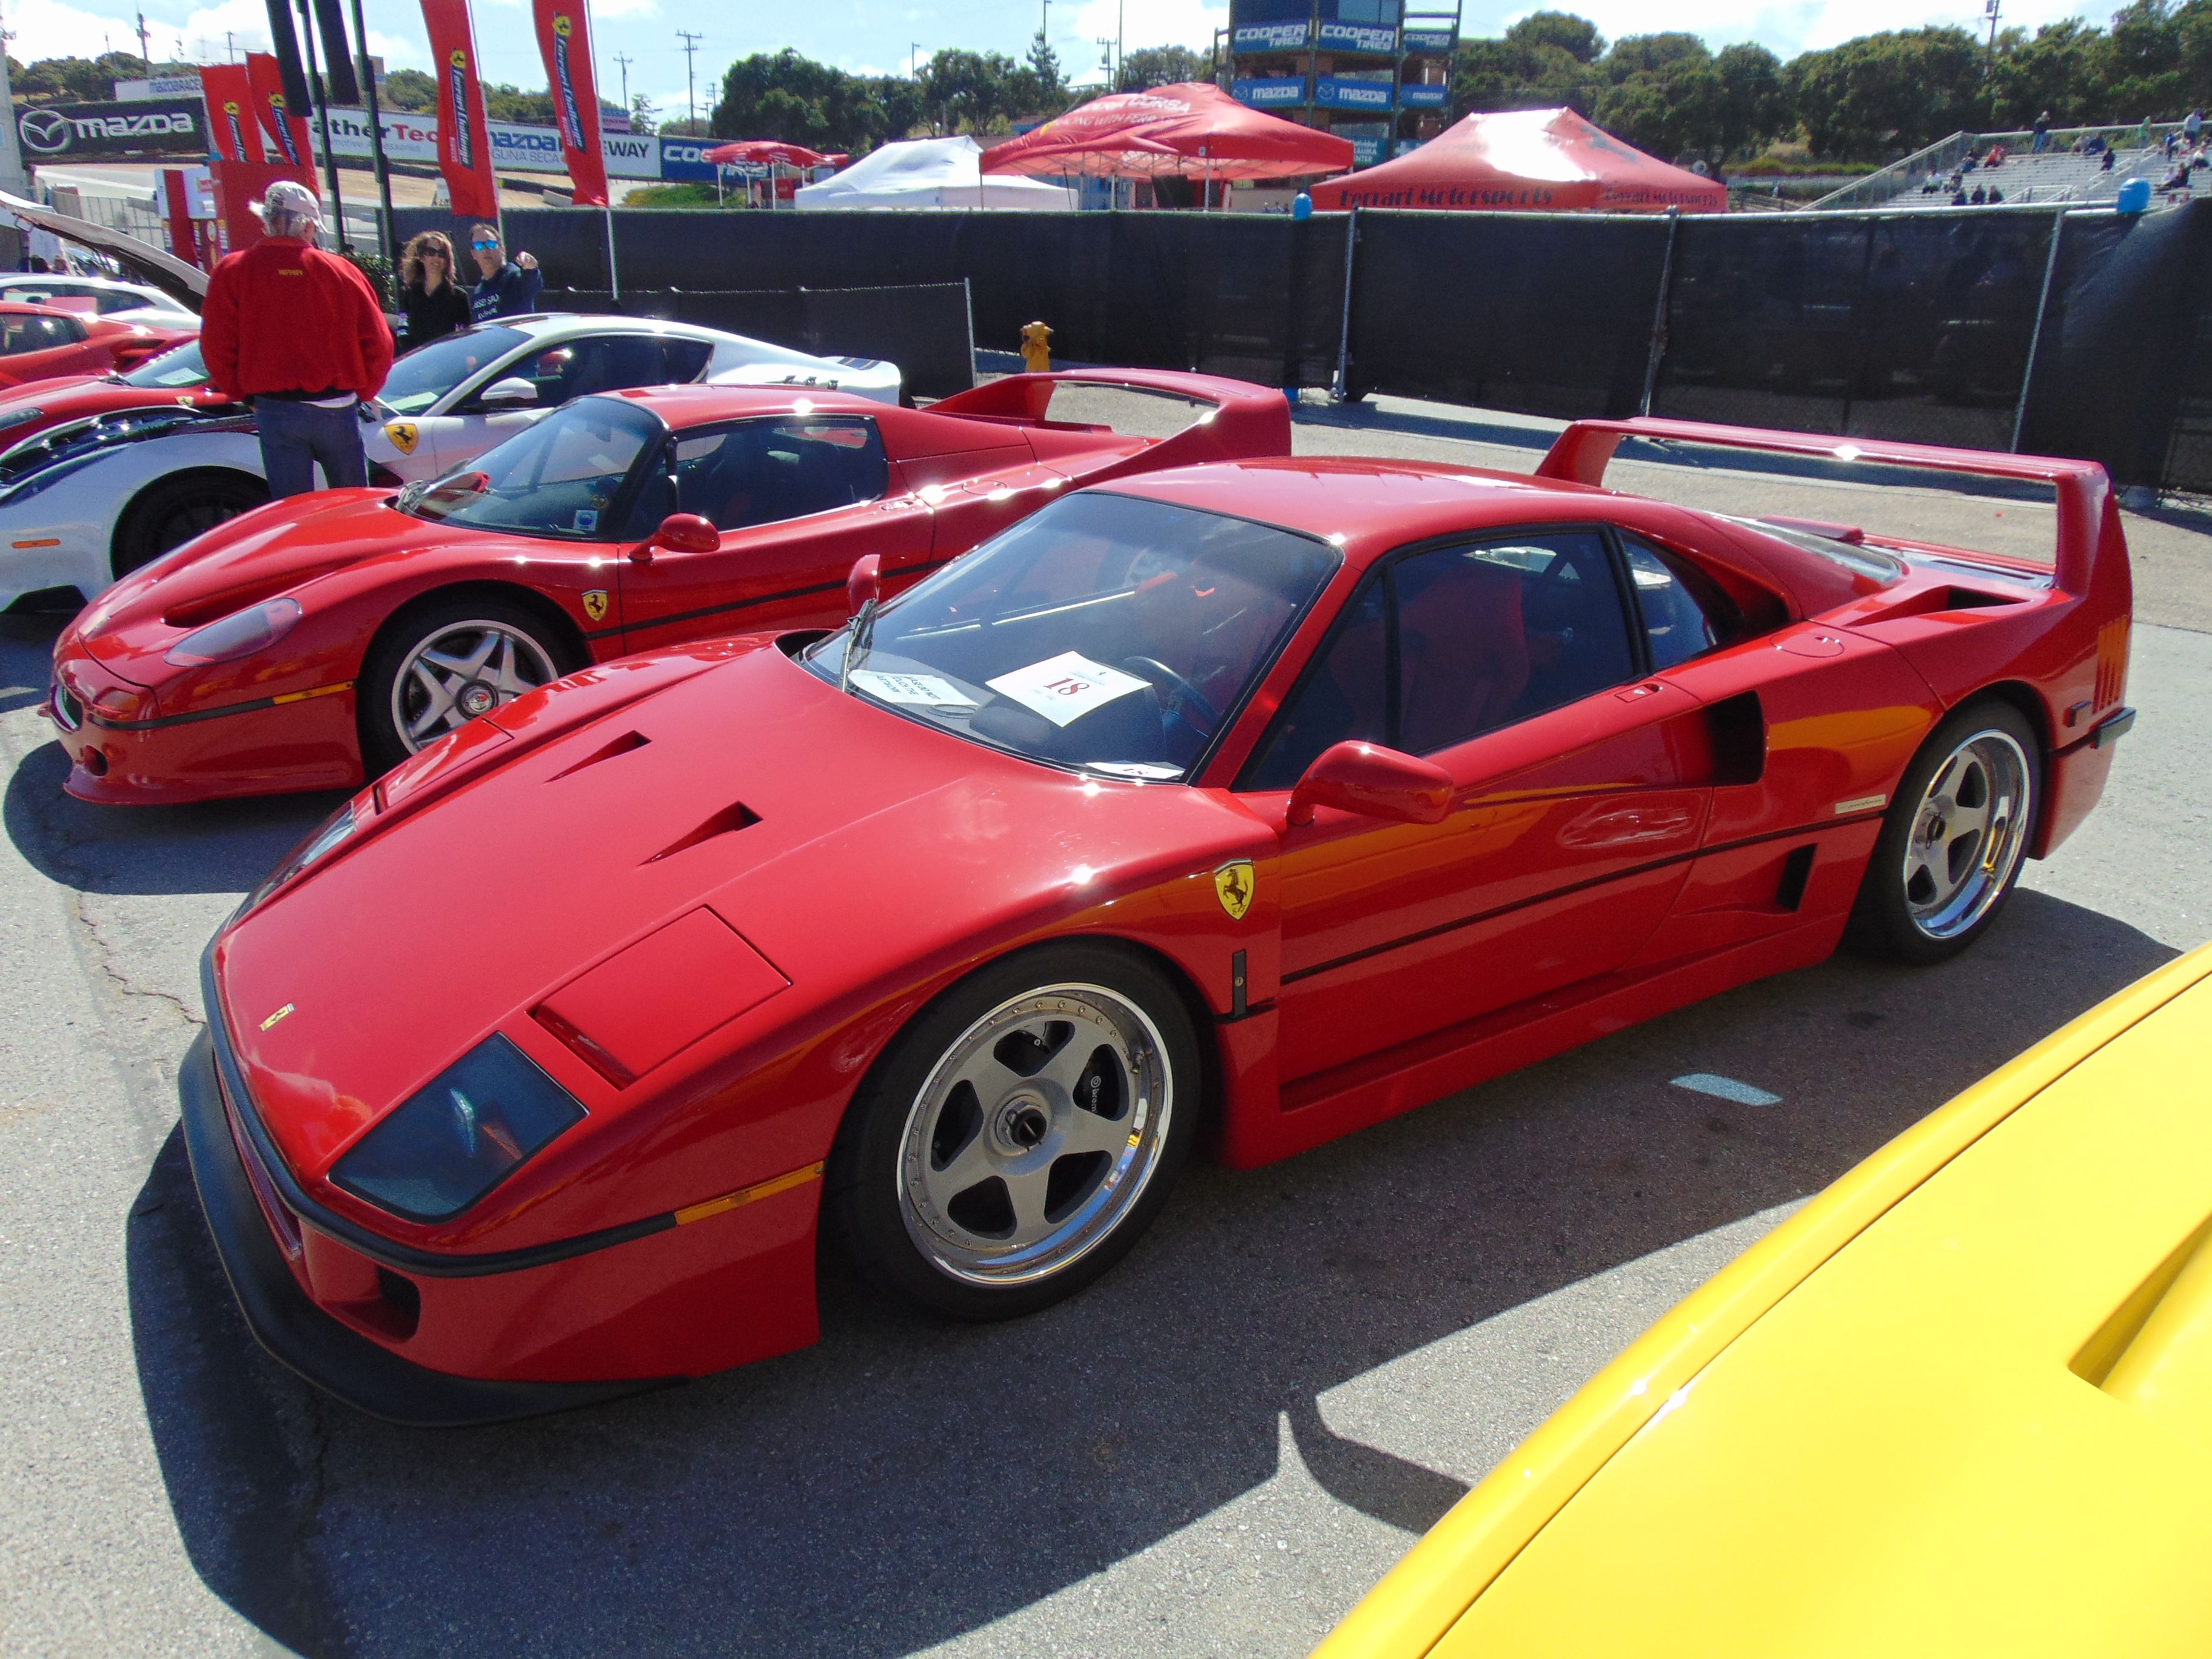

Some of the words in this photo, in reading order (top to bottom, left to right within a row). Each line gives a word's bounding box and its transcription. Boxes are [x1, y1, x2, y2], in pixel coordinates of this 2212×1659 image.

[1235, 24, 1307, 41] COOPER
[1321, 24, 1395, 42] COOPER
[1404, 32, 1450, 42] COOPER
[1269, 36, 1304, 47] TIRES
[1356, 38, 1392, 50] TIRES
[1253, 86, 1298, 99] mazda
[1339, 87, 1387, 102] mazda
[1412, 92, 1443, 101] mazda
[75, 113, 195, 138] mazda
[312, 118, 438, 143] atherTec
[490, 130, 557, 152] azda
[492, 150, 527, 161] GUNA
[530, 152, 560, 164] SECA
[1042, 677, 1090, 695] 18
[1091, 1088, 1099, 1114] brem
